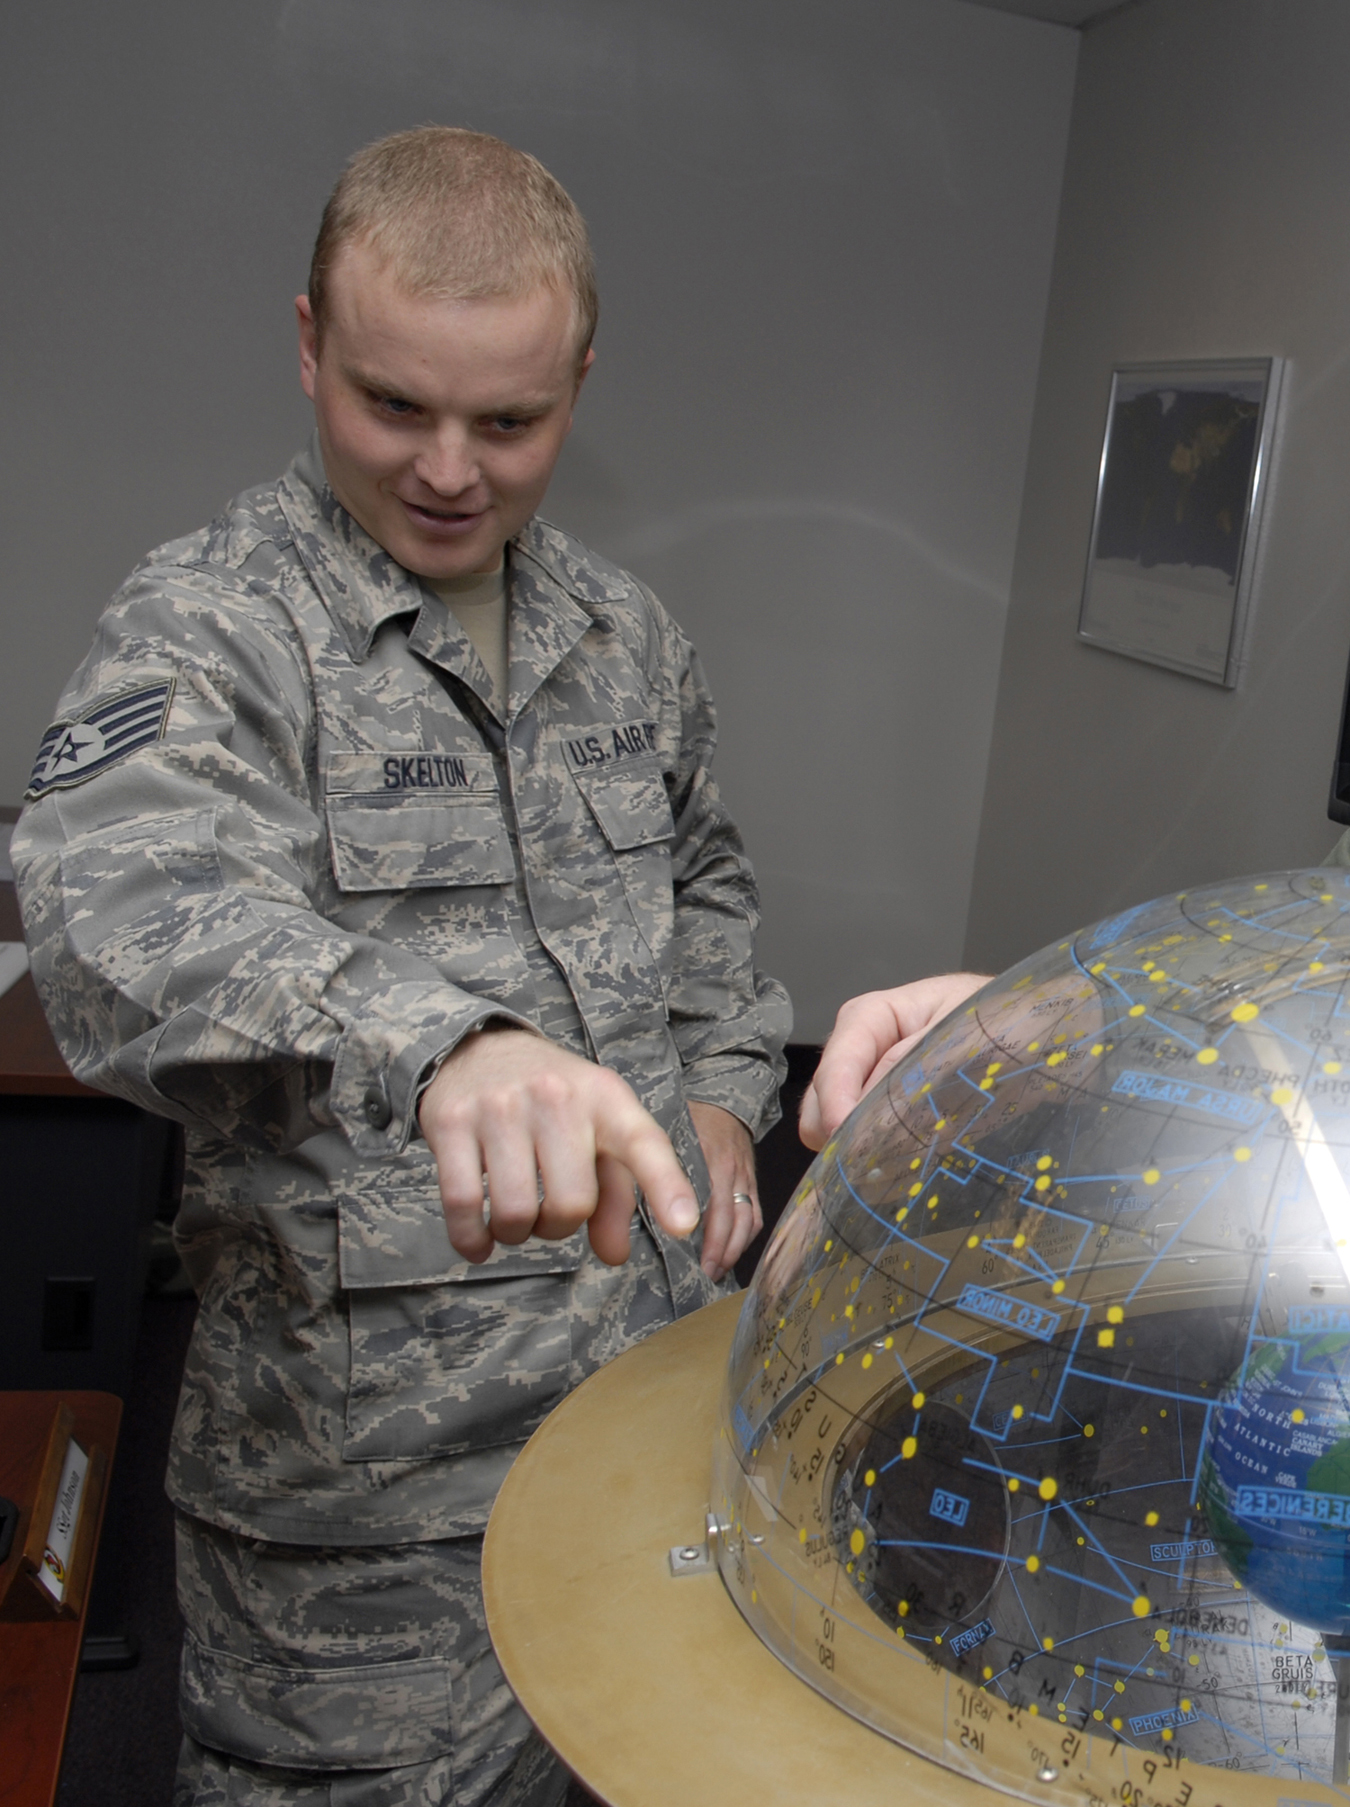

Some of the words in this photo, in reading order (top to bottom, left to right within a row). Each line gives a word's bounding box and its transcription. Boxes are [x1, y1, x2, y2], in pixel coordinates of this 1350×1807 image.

[569, 736, 610, 767] U.S.
[384, 757, 468, 789] SKELTON
[1251, 1402, 1293, 1430] NORTH
[1233, 1422, 1292, 1457] ATLANTIC
[1234, 1451, 1270, 1475] OCEAN
[1272, 1667, 1314, 1681] GRUIS
[1275, 1654, 1314, 1670] BETA
[1133, 1706, 1197, 1734] PHOENIX
